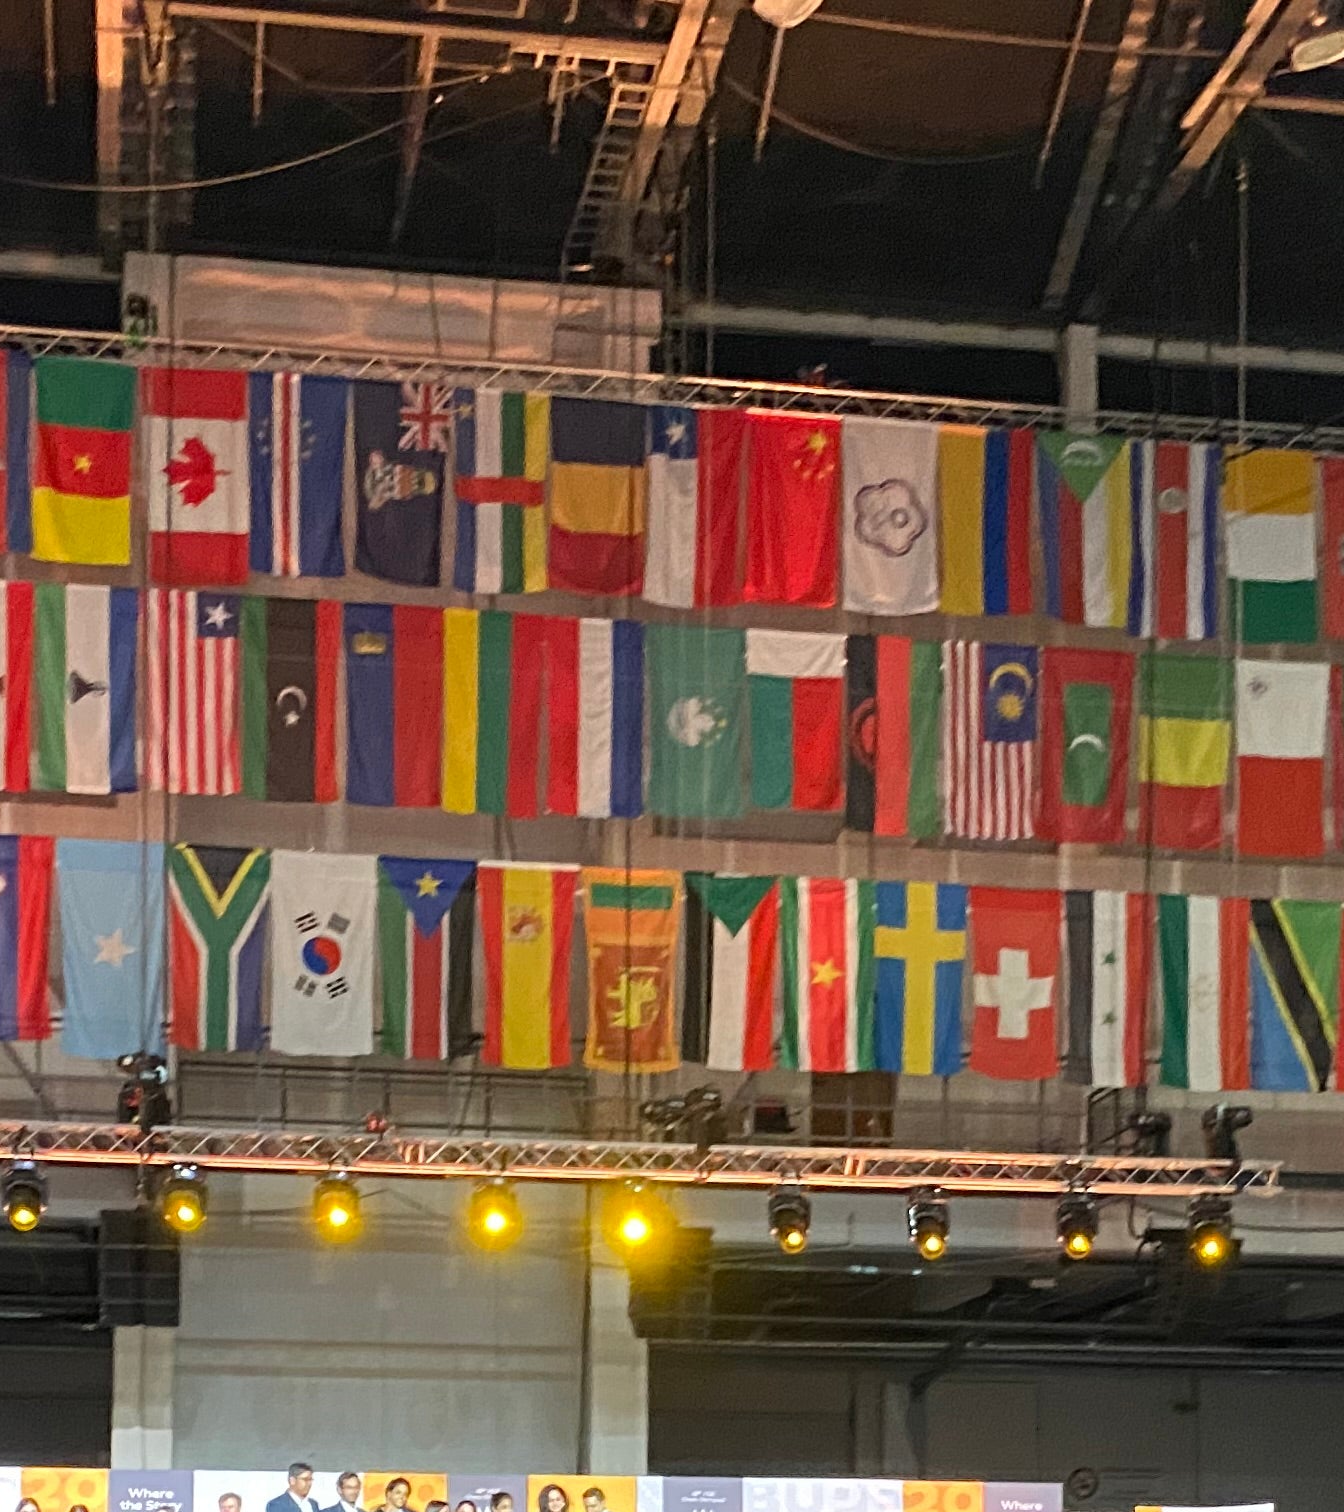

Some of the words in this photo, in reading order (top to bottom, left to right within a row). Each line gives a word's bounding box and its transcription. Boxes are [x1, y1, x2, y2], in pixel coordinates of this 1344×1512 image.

[128, 1487, 175, 1499] Where
[119, 1500, 143, 1511] the
[1000, 1500, 1043, 1511] Where
